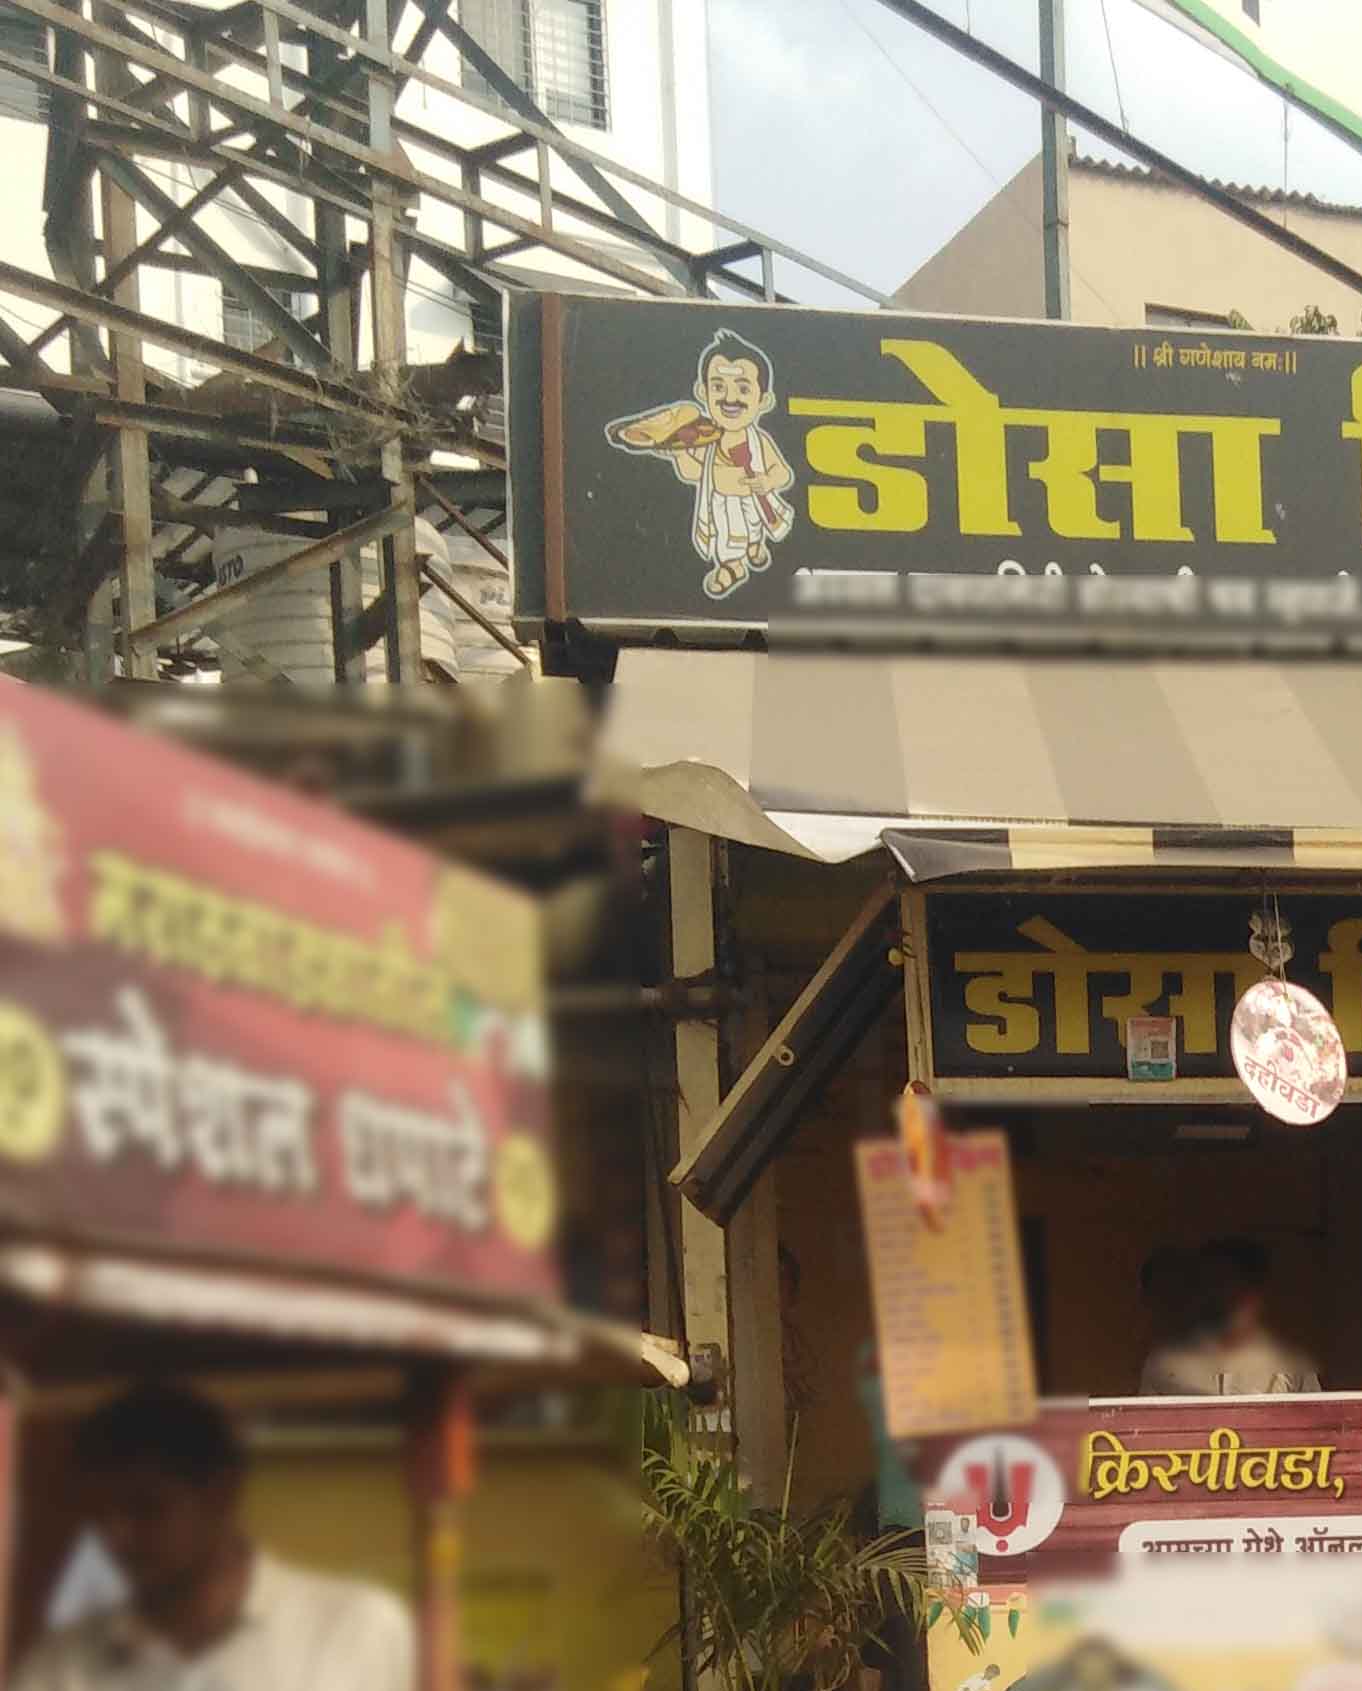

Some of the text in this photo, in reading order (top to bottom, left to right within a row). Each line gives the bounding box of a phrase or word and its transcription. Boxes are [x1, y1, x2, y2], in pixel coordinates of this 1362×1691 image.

[1152, 341, 1174, 368] श्री
[789, 340, 1281, 544] डोसा
[1244, 1055, 1321, 1120] दहीवडा
